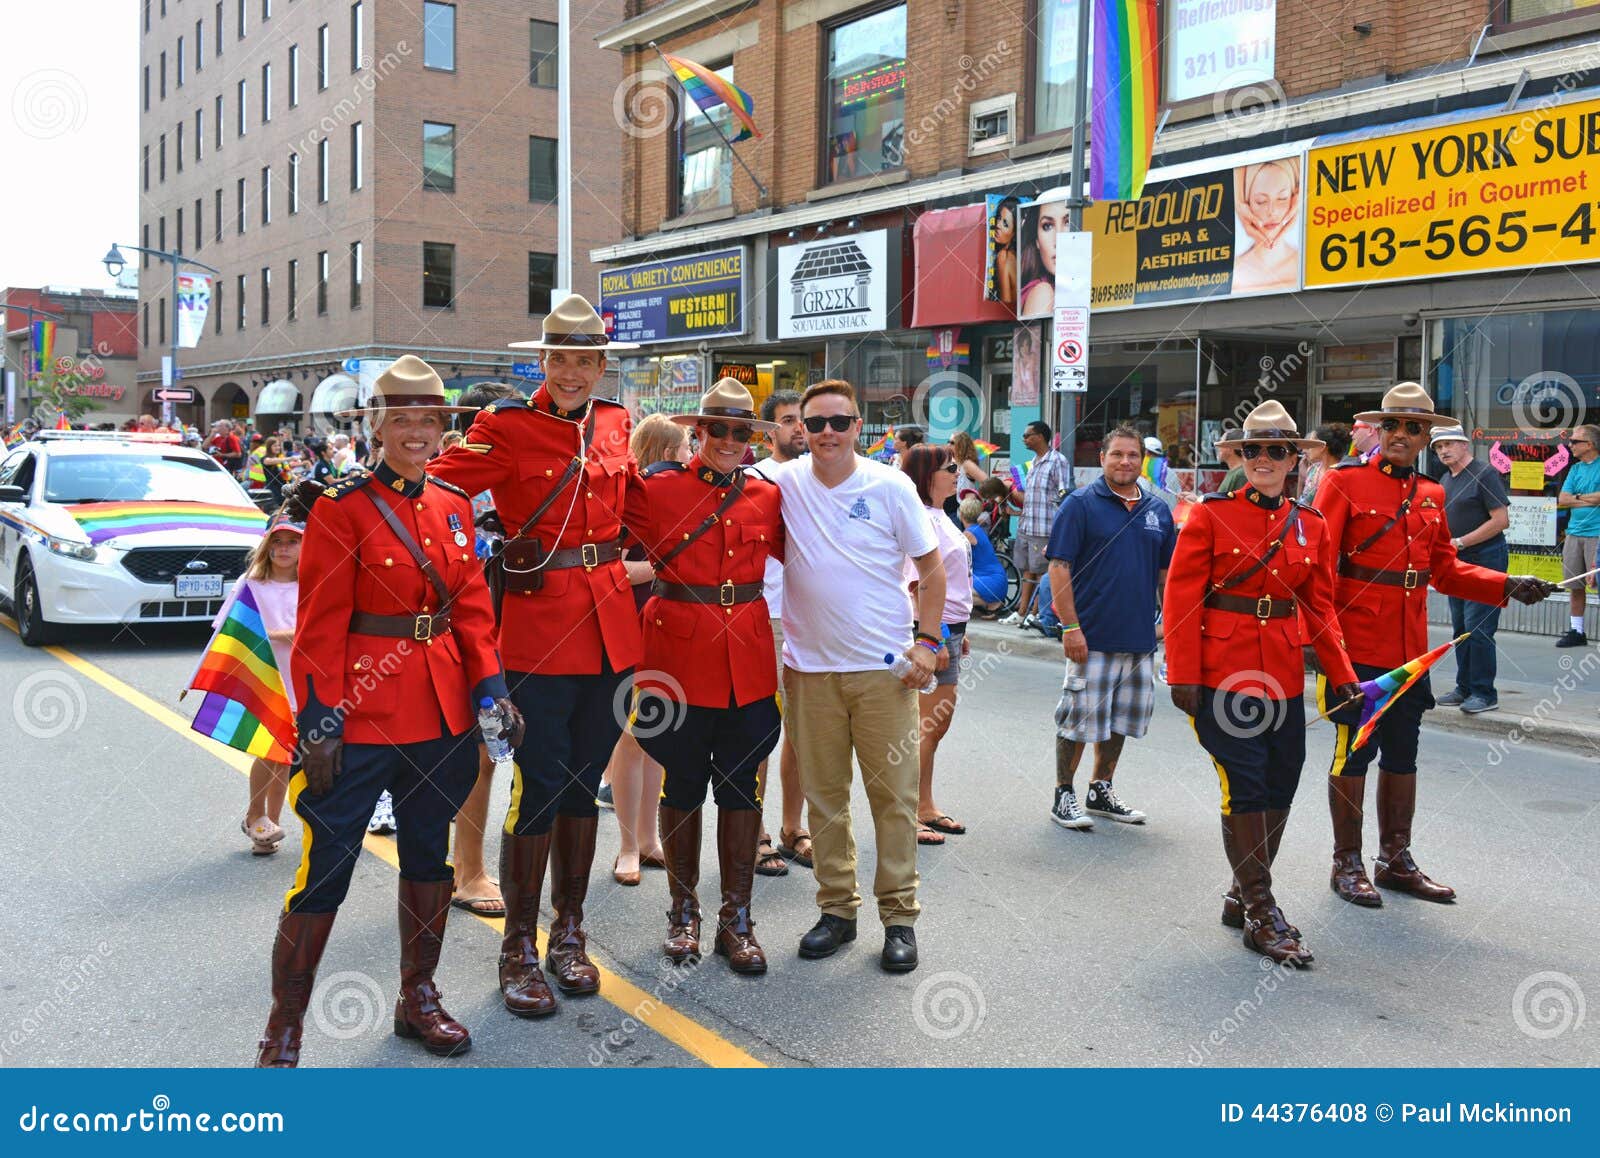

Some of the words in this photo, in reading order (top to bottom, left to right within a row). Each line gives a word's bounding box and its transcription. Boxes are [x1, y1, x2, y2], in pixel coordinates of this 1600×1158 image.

[1185, 51, 1216, 79] 321
[1224, 37, 1271, 69] 0571
[1316, 146, 1396, 197] NEW
[1412, 126, 1518, 180] YORK
[1105, 183, 1224, 235] REDOUND
[1312, 191, 1436, 228] Specialized
[1448, 188, 1468, 208] in
[1479, 170, 1588, 204] Gourmet
[1161, 231, 1192, 248] SPA
[1197, 228, 1210, 242] &
[1320, 202, 1600, 272] 613-565-4
[1140, 246, 1231, 271] AESTHETICS
[603, 275, 629, 292] ROYAL
[631, 268, 668, 289] VARIETY
[671, 256, 741, 282] CONVENIENCE
[1137, 271, 1230, 293] www.redoundspa.com
[669, 292, 725, 315] WESTERN
[685, 310, 726, 329] UNION
[792, 317, 837, 333] SOUVLAKI
[838, 314, 868, 328] SHACK
[719, 364, 754, 385] ATM
[1497, 379, 1559, 405] OPEN
